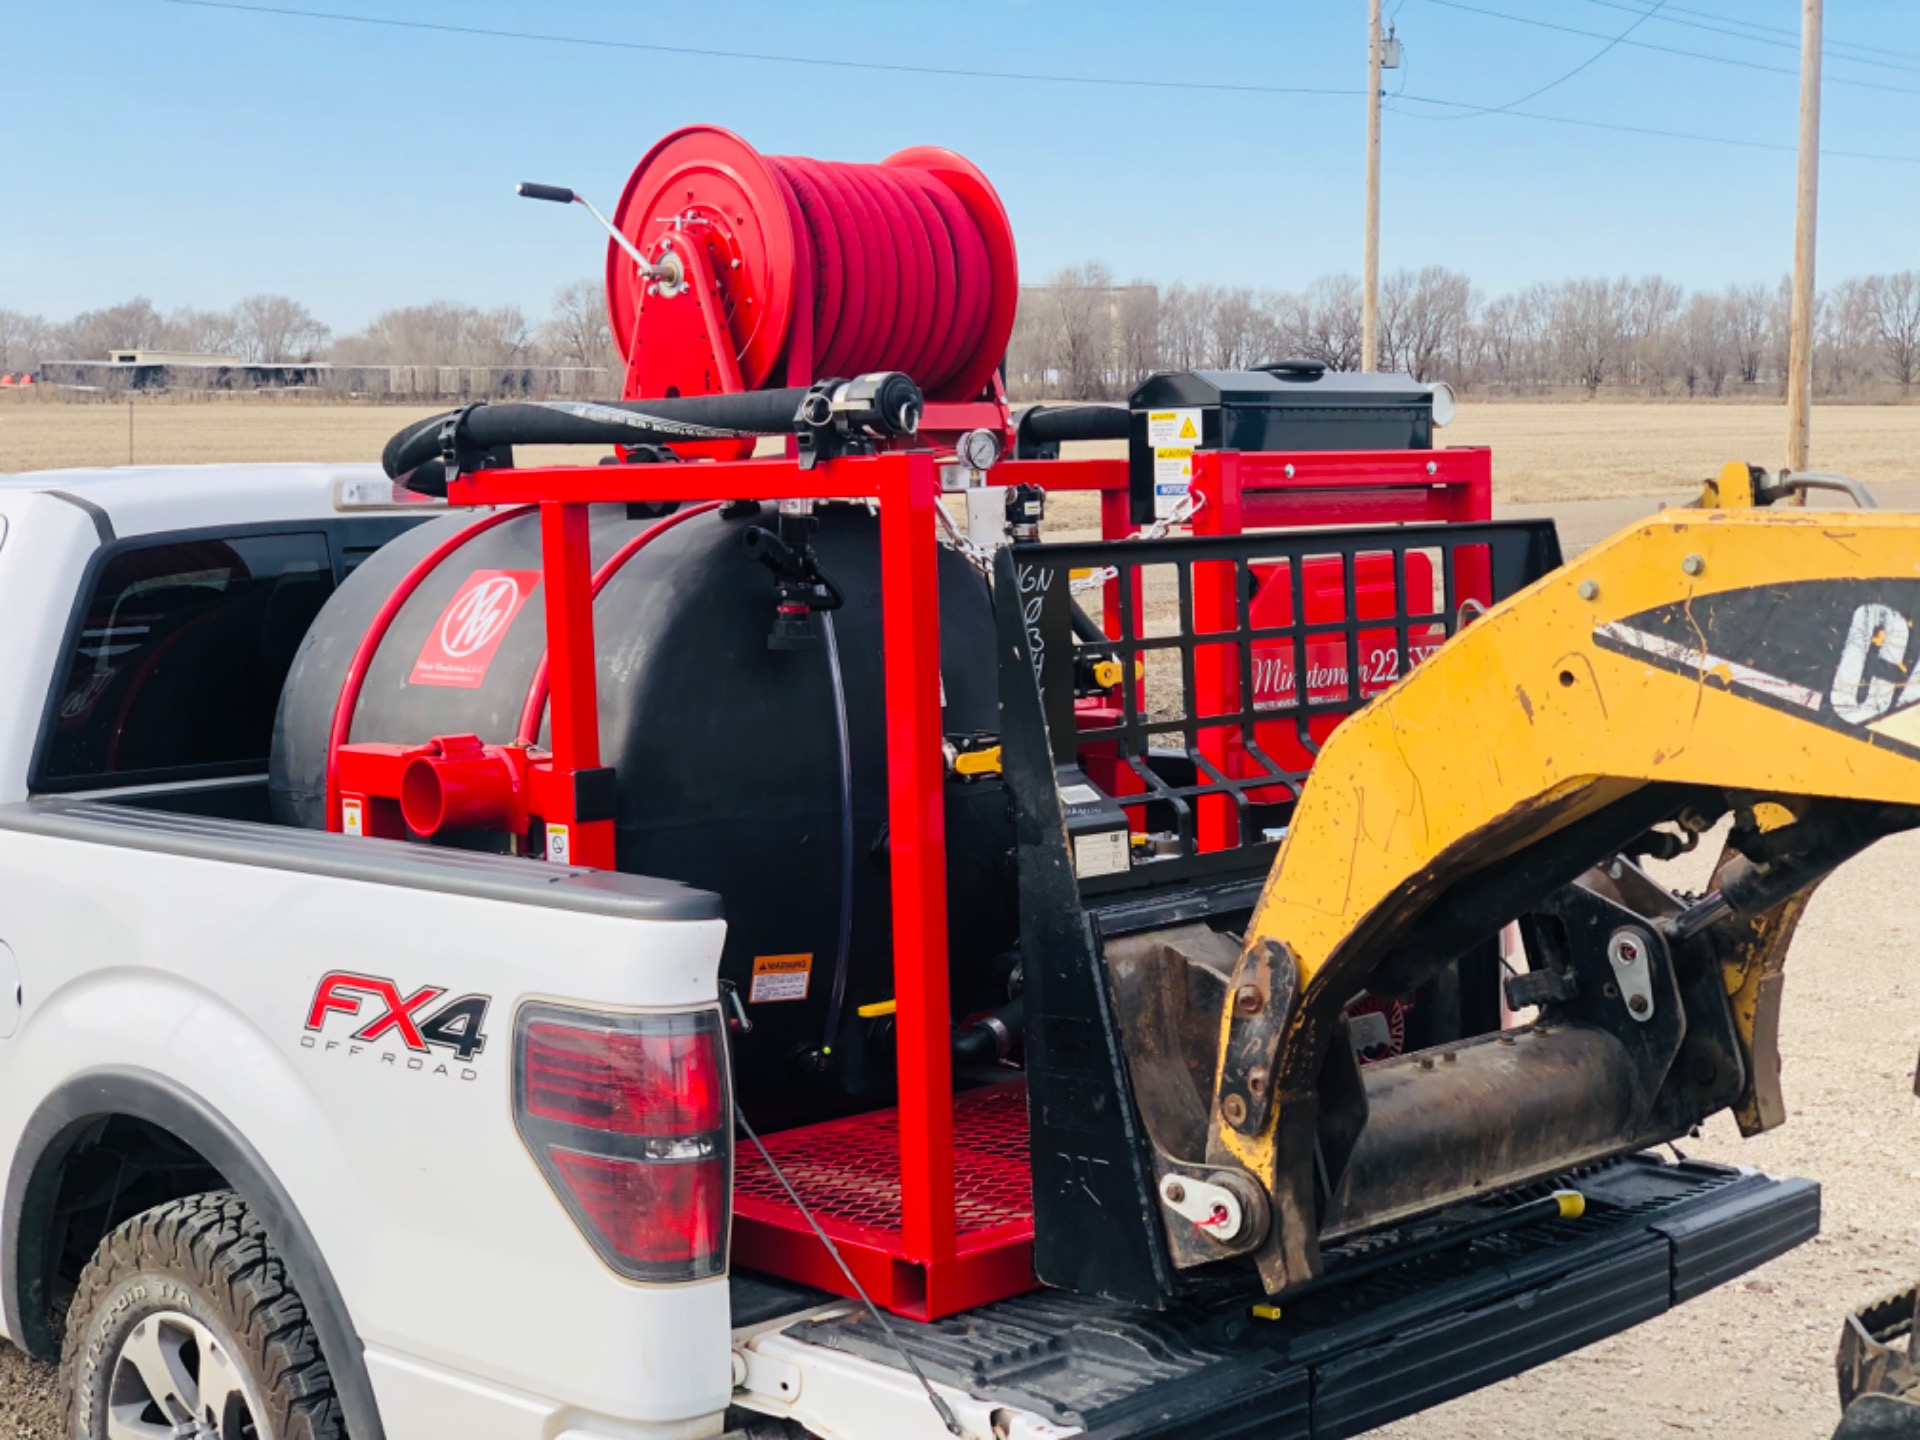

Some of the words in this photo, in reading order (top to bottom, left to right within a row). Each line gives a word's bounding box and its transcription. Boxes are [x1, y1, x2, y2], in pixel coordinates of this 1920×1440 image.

[1252, 658, 1370, 694] Minutemn
[767, 960, 807, 970] WARNING
[304, 969, 492, 1062] FX4
[300, 1035, 364, 1056] OFF
[380, 1052, 478, 1081] ROAD
